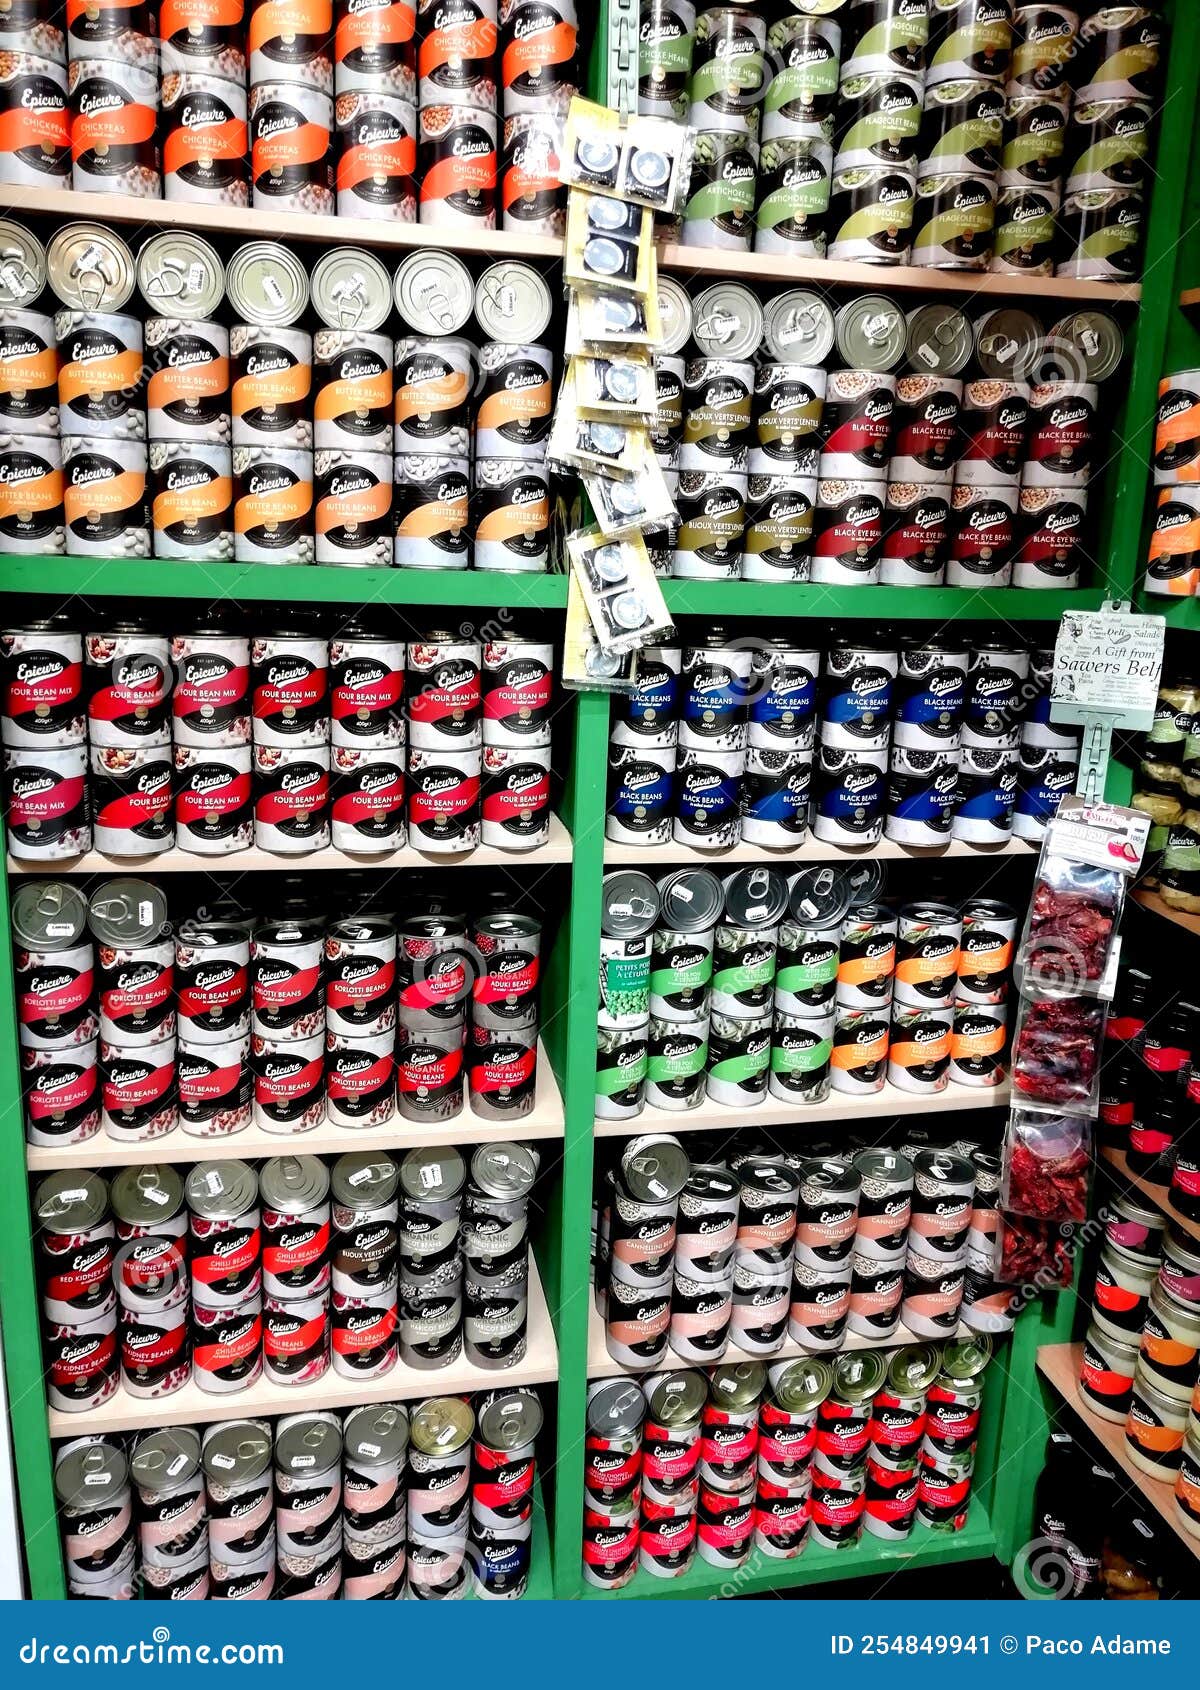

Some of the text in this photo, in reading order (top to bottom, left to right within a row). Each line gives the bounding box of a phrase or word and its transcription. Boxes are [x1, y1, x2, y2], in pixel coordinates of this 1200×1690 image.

[173, 1, 220, 14] CHICKPEAS
[514, 16, 555, 40] Epicure
[775, 73, 814, 85] ARTICHOKE
[22, 89, 64, 115] Epicure
[880, 94, 912, 115] Epicure
[182, 107, 227, 131] Epicure
[864, 117, 903, 127] FLAGEOLET
[80, 123, 126, 135] CHICKPEAS
[258, 115, 298, 141] Epicure
[1115, 121, 1146, 138] Epicure
[182, 135, 228, 148] CHICKPEAS
[1014, 139, 1050, 148] FLAGEOLET
[453, 139, 490, 161] Epicure
[359, 153, 401, 165] CHICKPEAS
[768, 195, 807, 204] ARTICHOKE
[879, 187, 908, 206] Epicure
[939, 214, 977, 224] FLAGEOLET
[1013, 206, 1046, 224] Epicure
[68, 370, 125, 382] BUTTER BEANS
[340, 362, 382, 383] Epicure
[163, 375, 218, 387] BUTTER BEANS
[505, 372, 544, 392] Epicure
[243, 384, 296, 395] BUTTER BEANS
[771, 393, 809, 413] Epicure
[1049, 408, 1088, 429] Epicure
[1159, 399, 1192, 423] Epicure
[912, 426, 947, 436] BLACK EYE
[1038, 432, 1073, 440] BLACK EYE
[72, 467, 115, 489] Epicure
[250, 476, 292, 497] Epicure
[163, 497, 218, 508] BUTTER BEANS
[245, 501, 298, 513] BUTTER BEANS
[769, 503, 807, 522] Epicure
[969, 511, 1007, 531] Epicure
[1157, 513, 1191, 533] Epicure
[834, 529, 856, 537] BLACK
[858, 529, 868, 537] EYE
[981, 533, 992, 541] EYE
[1033, 535, 1068, 544] BLACK EYE
[1107, 628, 1126, 636] Deli
[1133, 629, 1160, 639] Salads
[1092, 646, 1101, 656] A
[1105, 646, 1127, 658] Gift
[1128, 648, 1155, 660] from
[1057, 655, 1121, 673] Sawers
[186, 664, 227, 686] Epicure
[438, 670, 475, 692] Epicure
[10, 687, 73, 696] FOUR BEAN MIX
[693, 674, 730, 694] Epicure
[976, 677, 1013, 696] Epicure
[338, 692, 392, 701] FOUR BEAN MIX
[498, 691, 548, 700] FOUR BEAN MIX
[689, 696, 711, 704] BLACK
[847, 698, 868, 706] BLACK
[191, 772, 232, 795] Epicure
[422, 776, 460, 797] Epicure
[624, 771, 660, 791] Epicure
[844, 774, 877, 793] Epicure
[185, 796, 241, 805] FOUR BEAN MIX
[416, 797, 433, 806] FOUR
[435, 798, 454, 807] BEAN
[620, 792, 662, 800] BLACK BEANS
[682, 794, 724, 804] BLACK BEANS
[743, 950, 775, 969] Epicure
[922, 945, 954, 960] Epicure
[499, 959, 526, 973] Epicure
[615, 963, 638, 972] PETITS
[118, 969, 159, 992] Epicure
[489, 970, 533, 981] ORGANIC
[490, 978, 532, 988] ADUKI BEANS
[58, 994, 82, 1005] BEANS
[962, 1024, 996, 1039] Epicure
[492, 1052, 519, 1063] Epicure
[336, 1059, 372, 1077] Epicure
[403, 1062, 446, 1073] ORGANIC
[483, 1061, 526, 1071] ORGANIC
[404, 1071, 421, 1080] ADUKI
[484, 1070, 525, 1079] ADUKI BEANS
[37, 1072, 78, 1094] Epicure
[64, 1090, 87, 1102] BEANS
[132, 1088, 158, 1097] BEANS
[820, 1210, 852, 1227] Epicure
[699, 1219, 731, 1236] Epicure
[214, 1234, 250, 1257] Epicure
[355, 1228, 389, 1249] Epicure
[73, 1245, 110, 1272] Epicure
[210, 1254, 253, 1267] CHILLI BEANS
[76, 1269, 101, 1282] KIDNEY
[484, 1306, 508, 1317] Epicure
[496, 1322, 518, 1331] BEANS
[127, 1332, 160, 1349] Epicure
[344, 1331, 385, 1342] CHILLI BEANS
[63, 1352, 112, 1371] KIDNEY BEANS
[128, 1348, 174, 1360] KIDNEY BEANS
[937, 1408, 968, 1423] Epicure
[714, 1431, 745, 1446] Epicure
[834, 1424, 864, 1439] Epicure
[654, 1447, 685, 1462] Epicure
[429, 1472, 463, 1492] Epicure
[921, 1471, 949, 1489] Epicure
[160, 1499, 195, 1523] Epicure
[412, 1551, 443, 1566] Epicure
